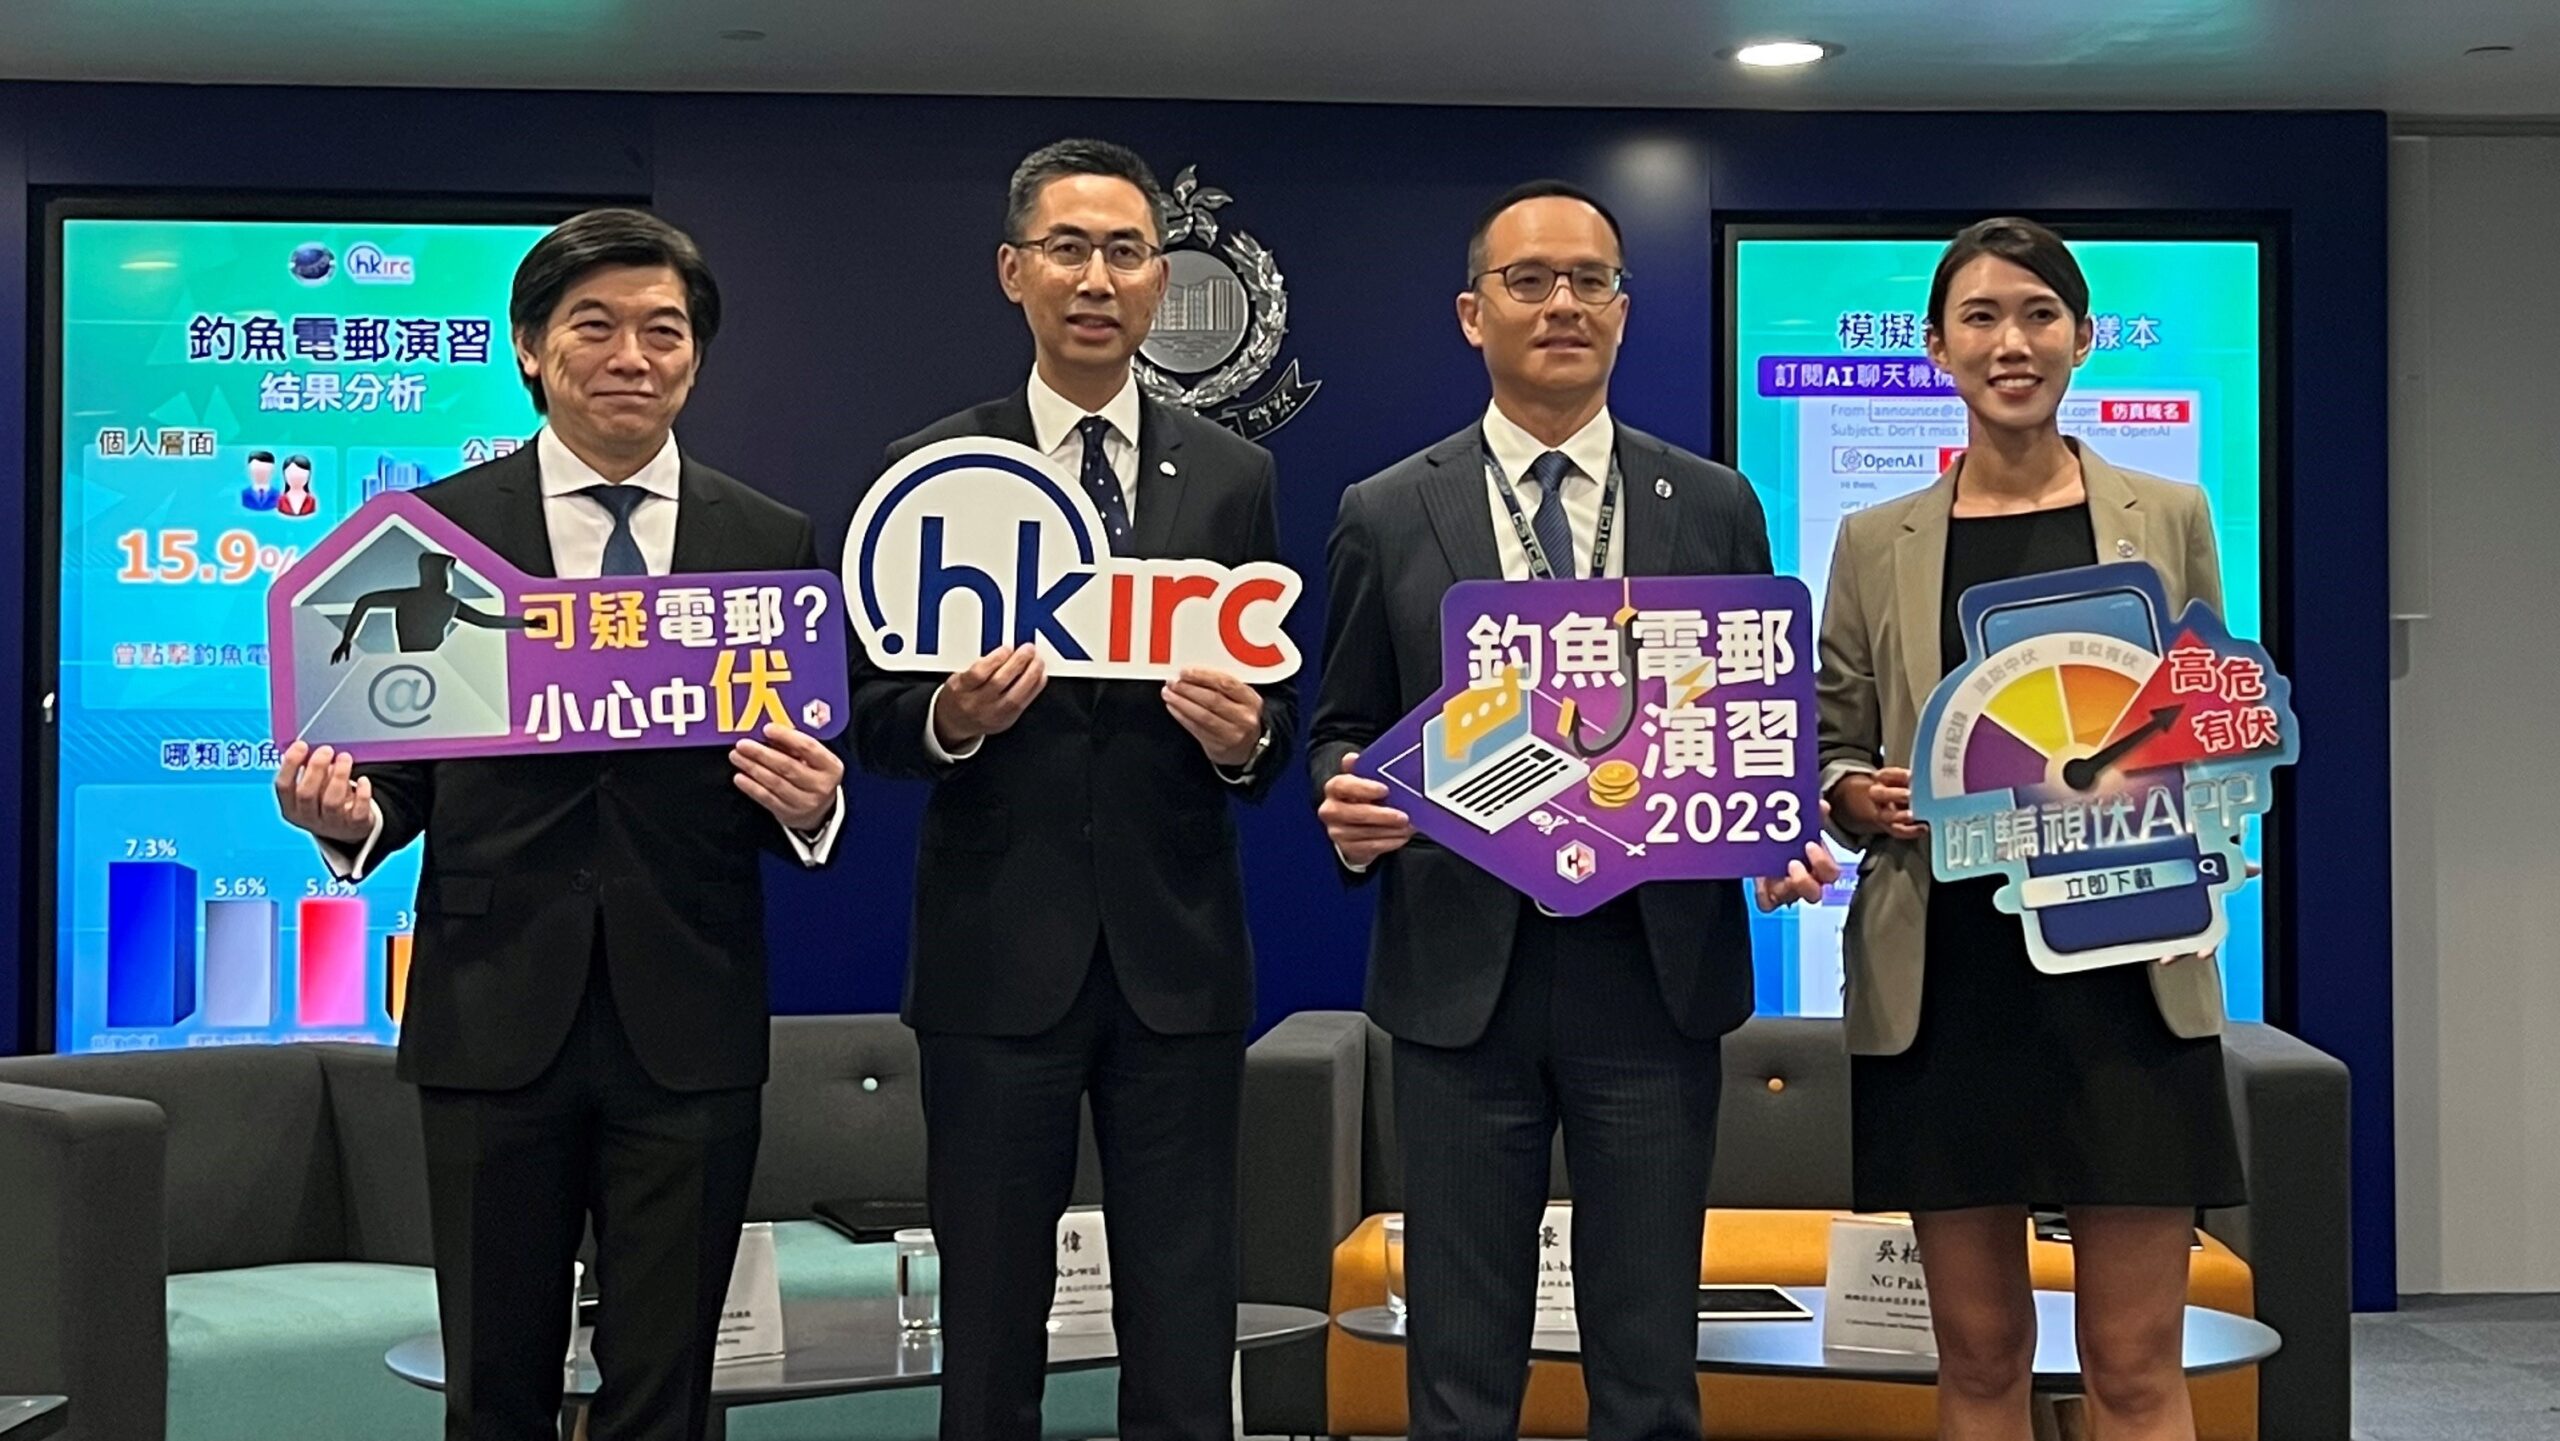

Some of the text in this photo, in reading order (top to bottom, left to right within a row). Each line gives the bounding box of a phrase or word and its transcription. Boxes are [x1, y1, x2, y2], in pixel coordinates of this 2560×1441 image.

[189, 315, 491, 364] 釣魚電郵演習
[259, 372, 427, 412] 結果分析
[100, 430, 215, 456] 個人層面
[1863, 453, 1924, 472] OpenAI
[1465, 609, 1796, 706] 釣魚電郵
[2168, 647, 2267, 704] 高危
[524, 648, 796, 743] 小心中伏
[1641, 699, 1799, 779] 演習
[2190, 705, 2280, 753] 有伏
[163, 741, 281, 767] 哪類釣魚
[1644, 791, 1802, 844] 2023
[125, 838, 177, 858] 7.3%
[215, 877, 358, 897] 5.6% 5.6%
[2064, 867, 2155, 900] 立即下載
